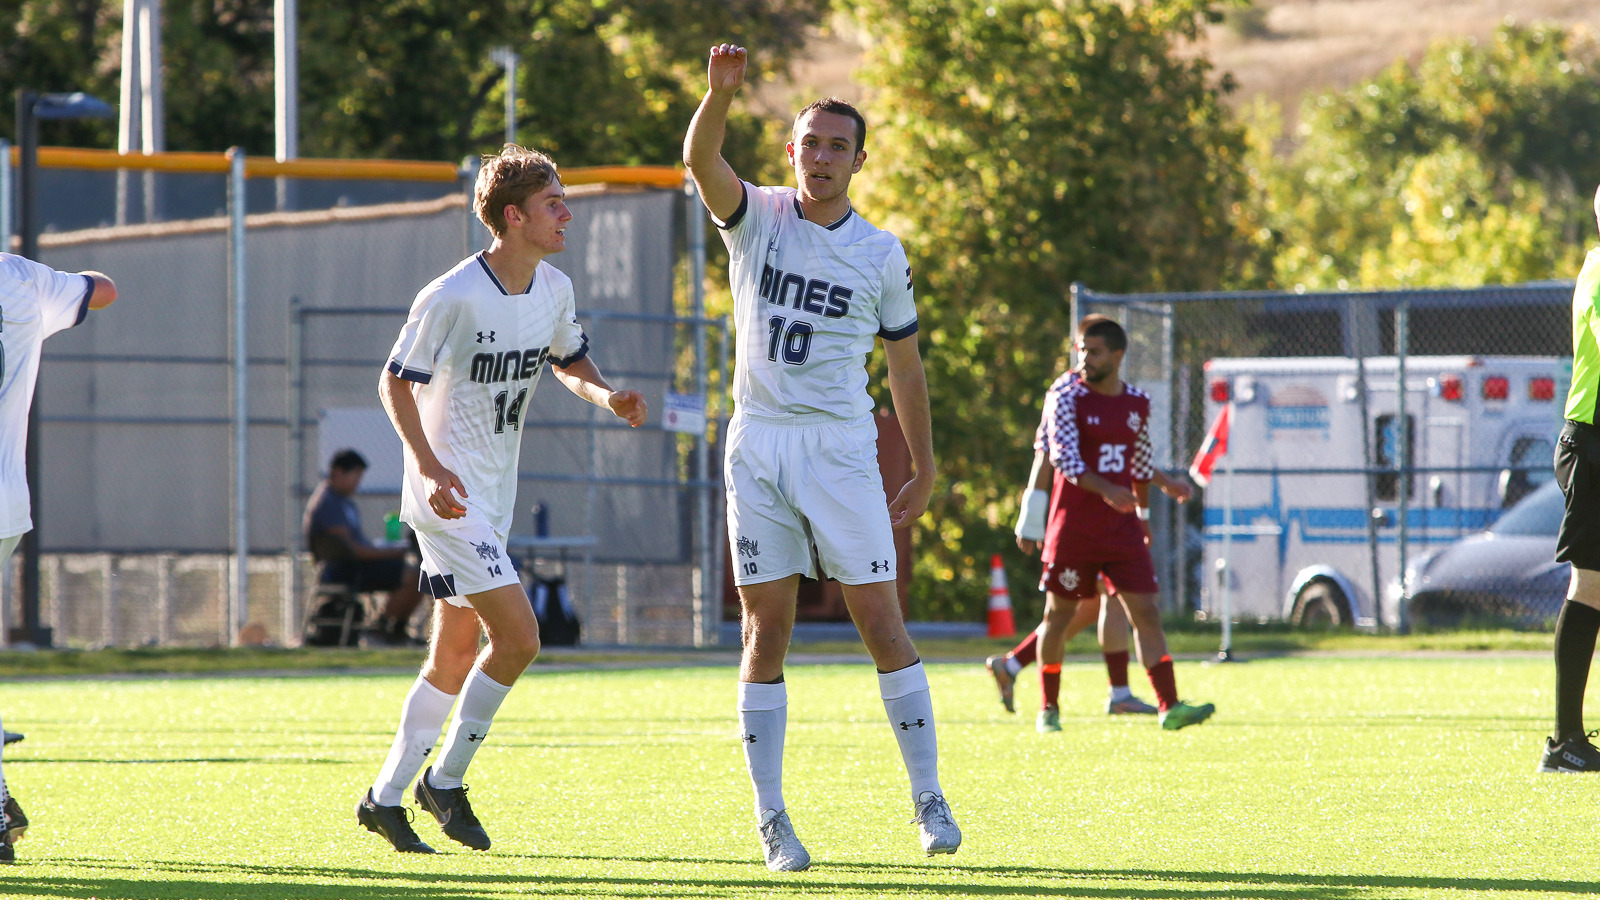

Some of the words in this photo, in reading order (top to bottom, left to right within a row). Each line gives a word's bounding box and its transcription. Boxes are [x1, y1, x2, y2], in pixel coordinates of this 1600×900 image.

[759, 264, 854, 319] MINES
[768, 315, 814, 366] 10
[493, 388, 528, 434] 14
[1098, 443, 1127, 473] 25
[487, 564, 502, 578] 14
[743, 562, 758, 576] 10
